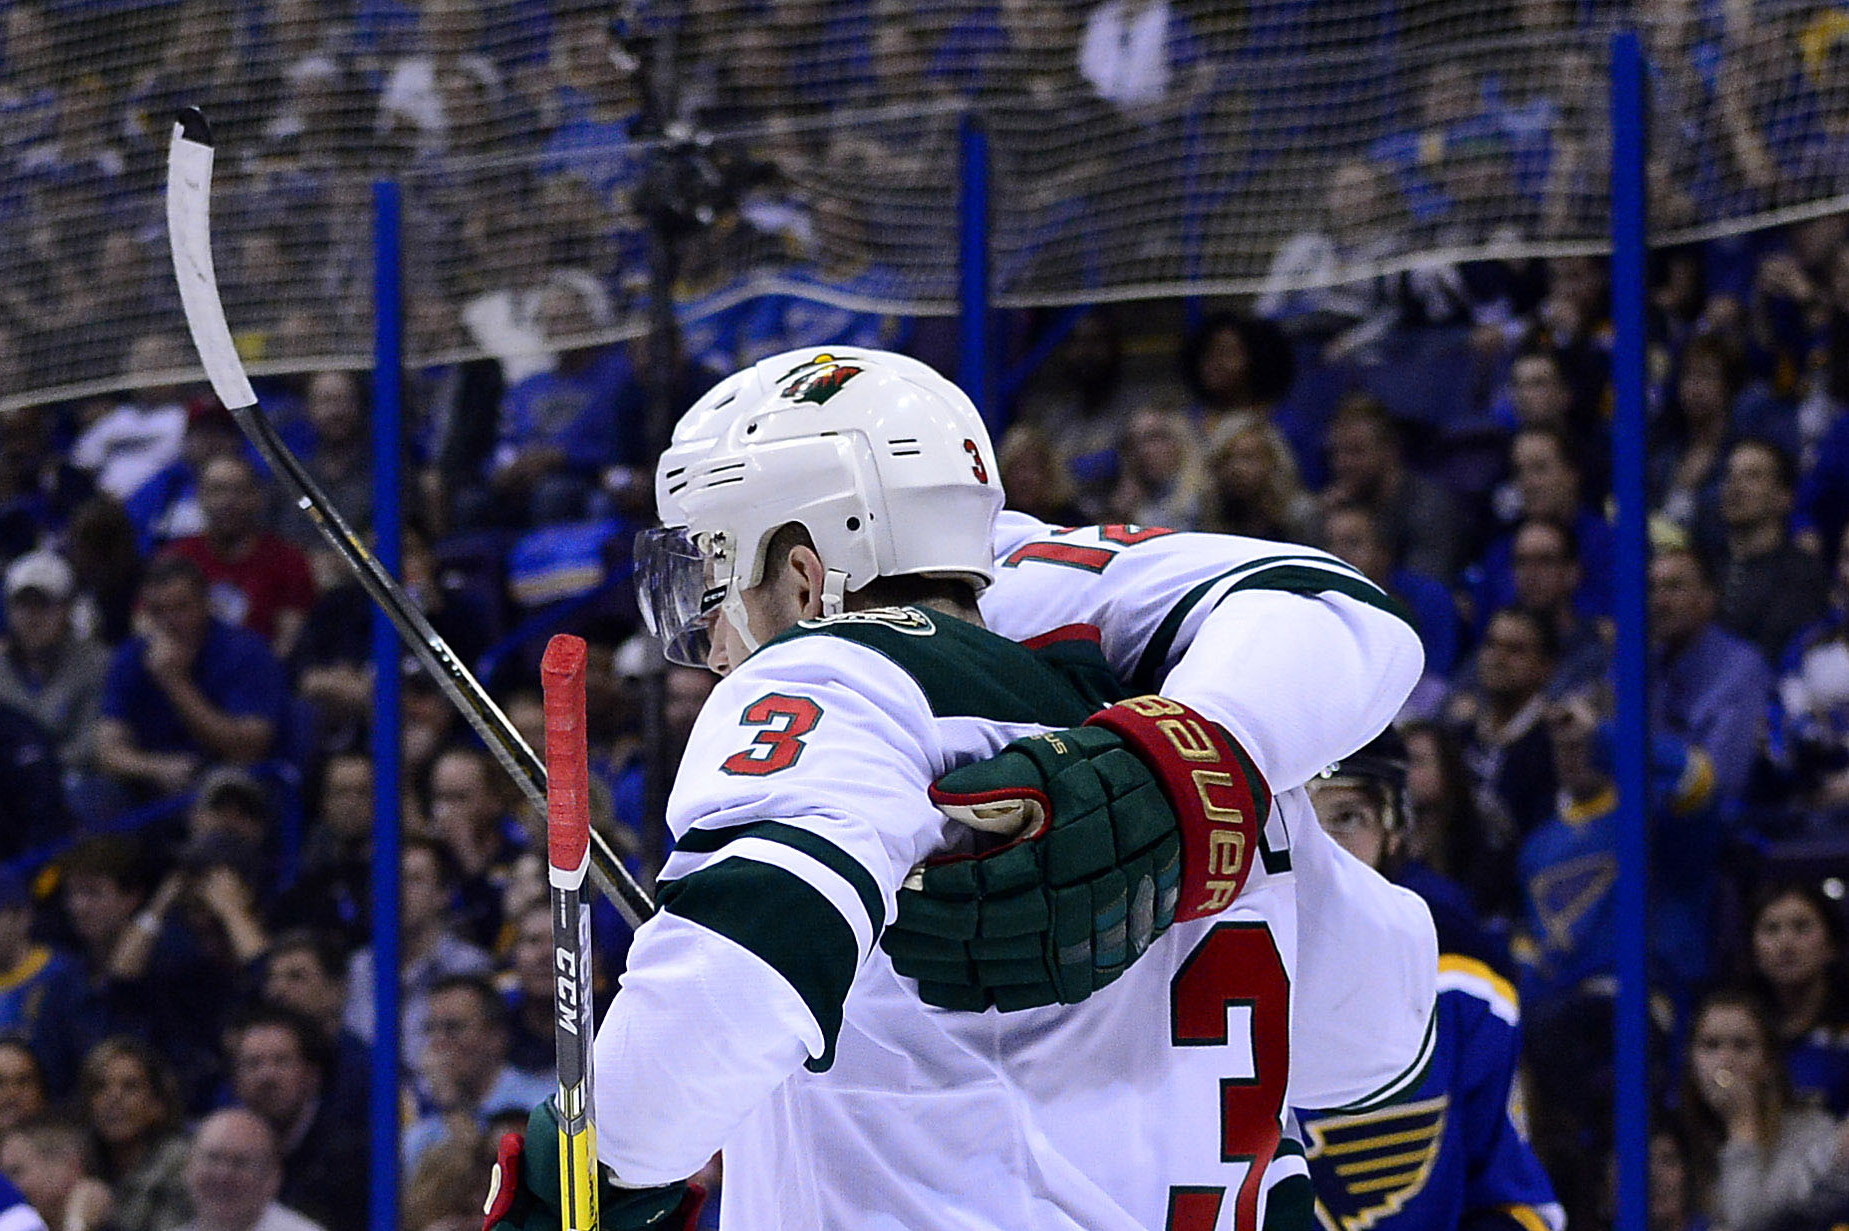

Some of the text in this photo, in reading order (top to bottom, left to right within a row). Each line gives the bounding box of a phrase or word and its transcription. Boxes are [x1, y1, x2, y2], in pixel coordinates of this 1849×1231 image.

[963, 438, 988, 486] 3
[719, 692, 825, 777] 3
[556, 946, 578, 1037] CCM
